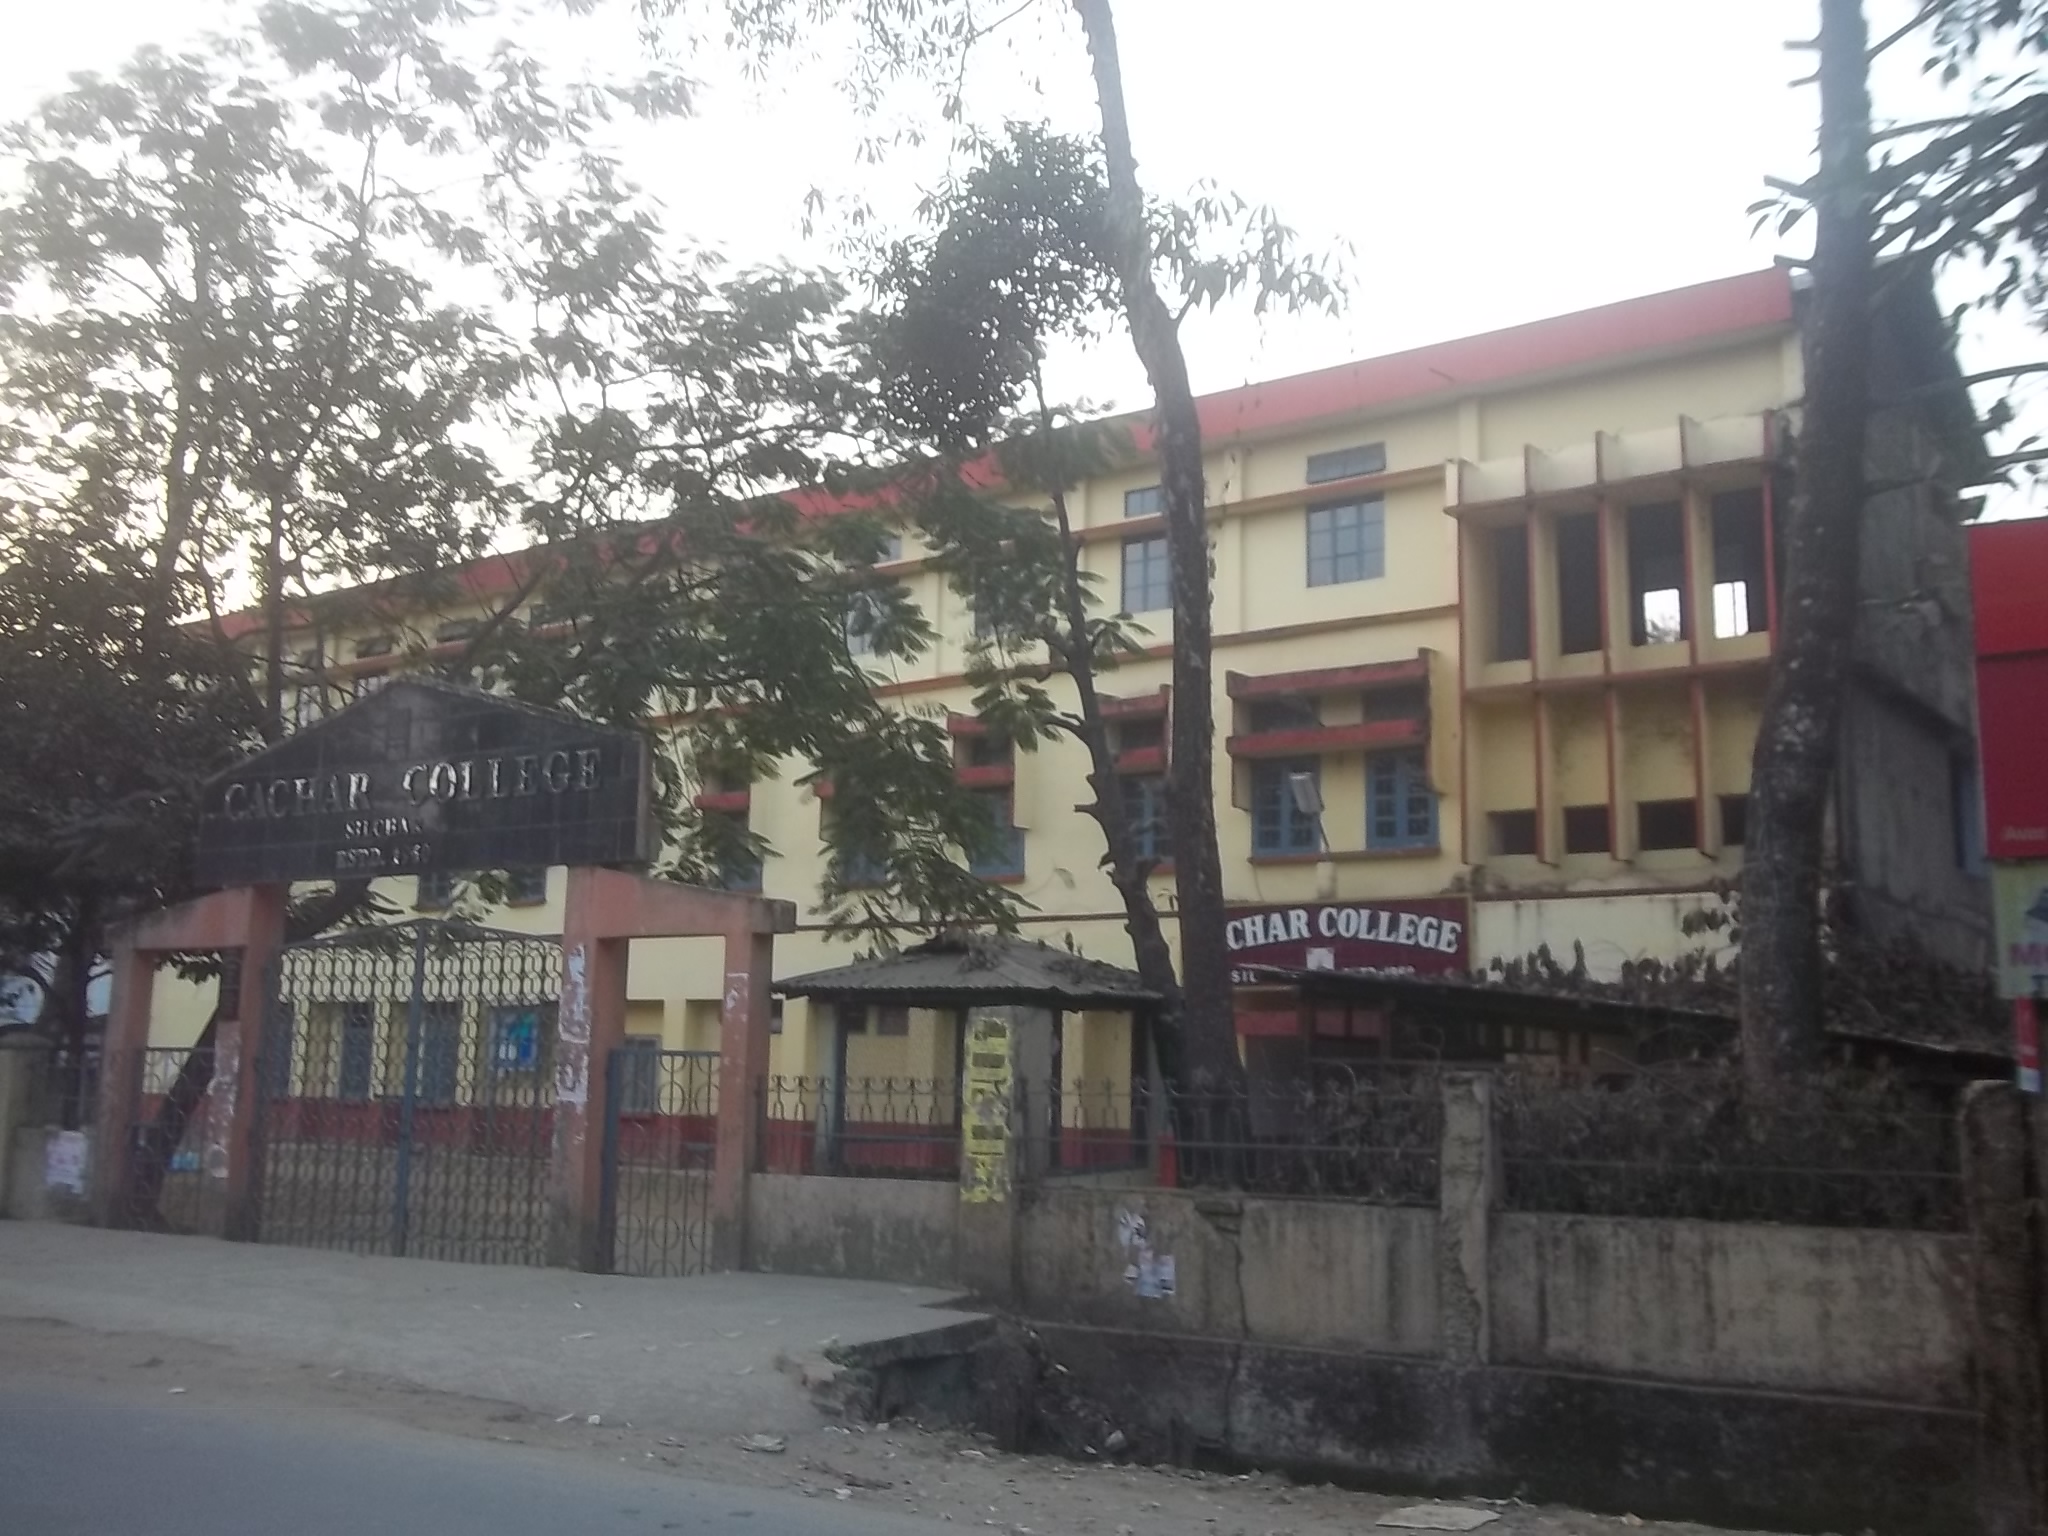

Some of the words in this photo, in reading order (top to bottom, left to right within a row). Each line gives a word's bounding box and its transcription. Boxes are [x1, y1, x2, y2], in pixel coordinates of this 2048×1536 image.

[224, 771, 371, 819] CACHAR
[402, 748, 602, 806] COLLEGE
[1225, 907, 1312, 950] CHAR
[1317, 906, 1462, 954] COLLEGE
